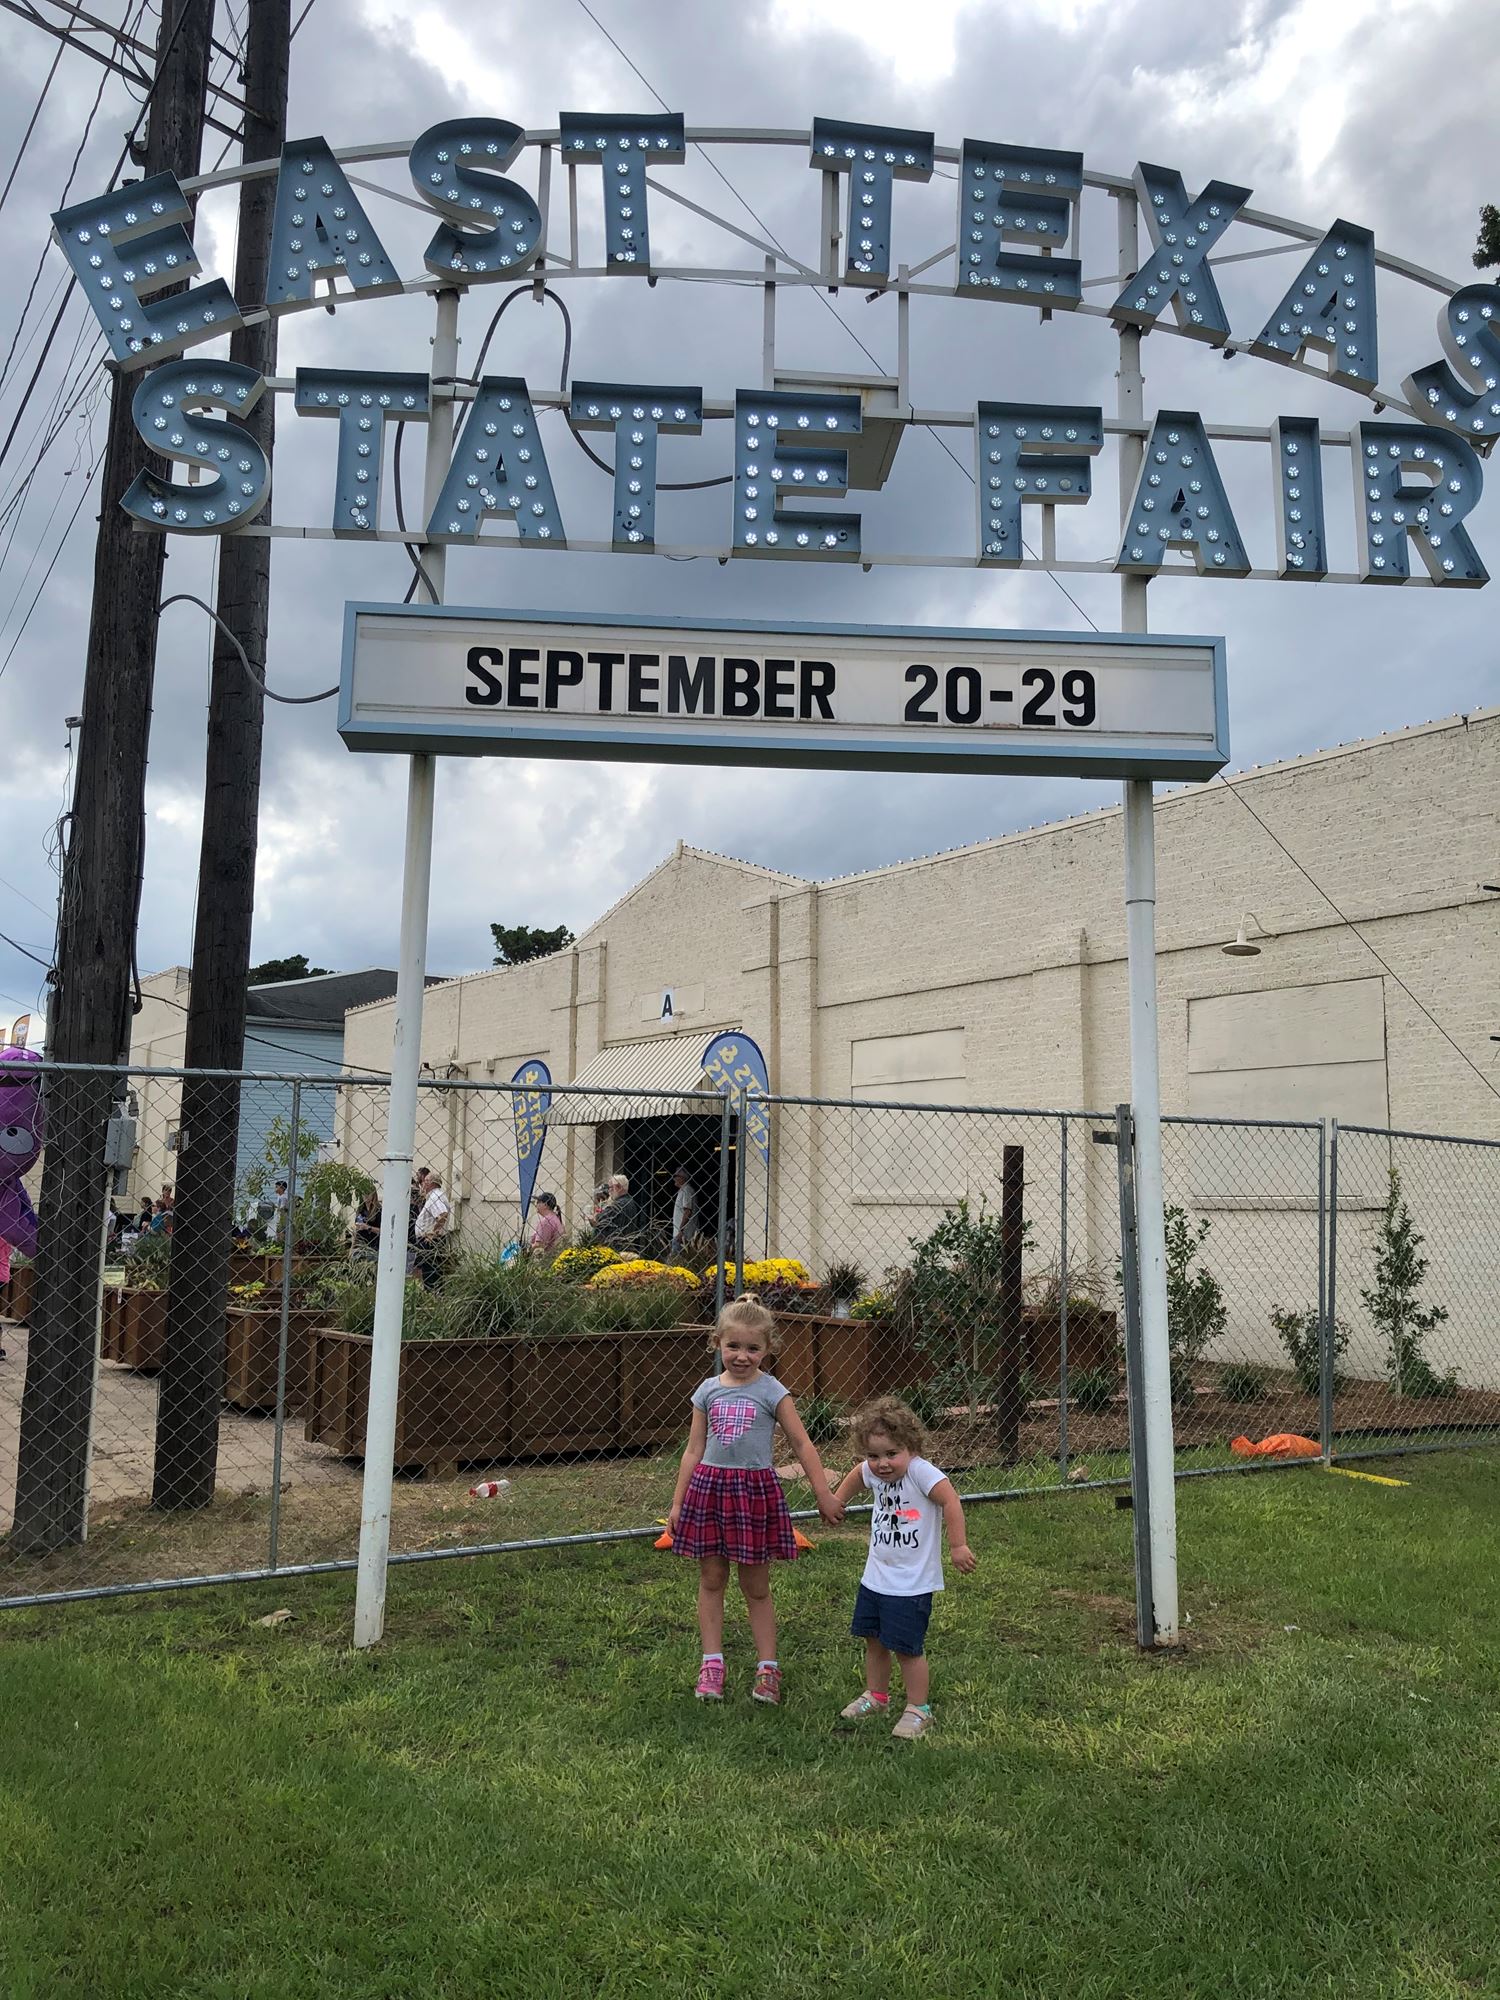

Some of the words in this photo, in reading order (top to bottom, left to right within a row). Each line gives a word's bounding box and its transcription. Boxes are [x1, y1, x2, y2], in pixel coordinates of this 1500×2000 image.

[51, 112, 685, 368] EAST
[810, 117, 1500, 437] TEXAS
[120, 359, 863, 561] STATE
[975, 401, 1490, 588] FAIR
[466, 647, 836, 720] SEPTEMBER
[904, 664, 1097, 727] 20-29
[661, 994, 673, 1018] A
